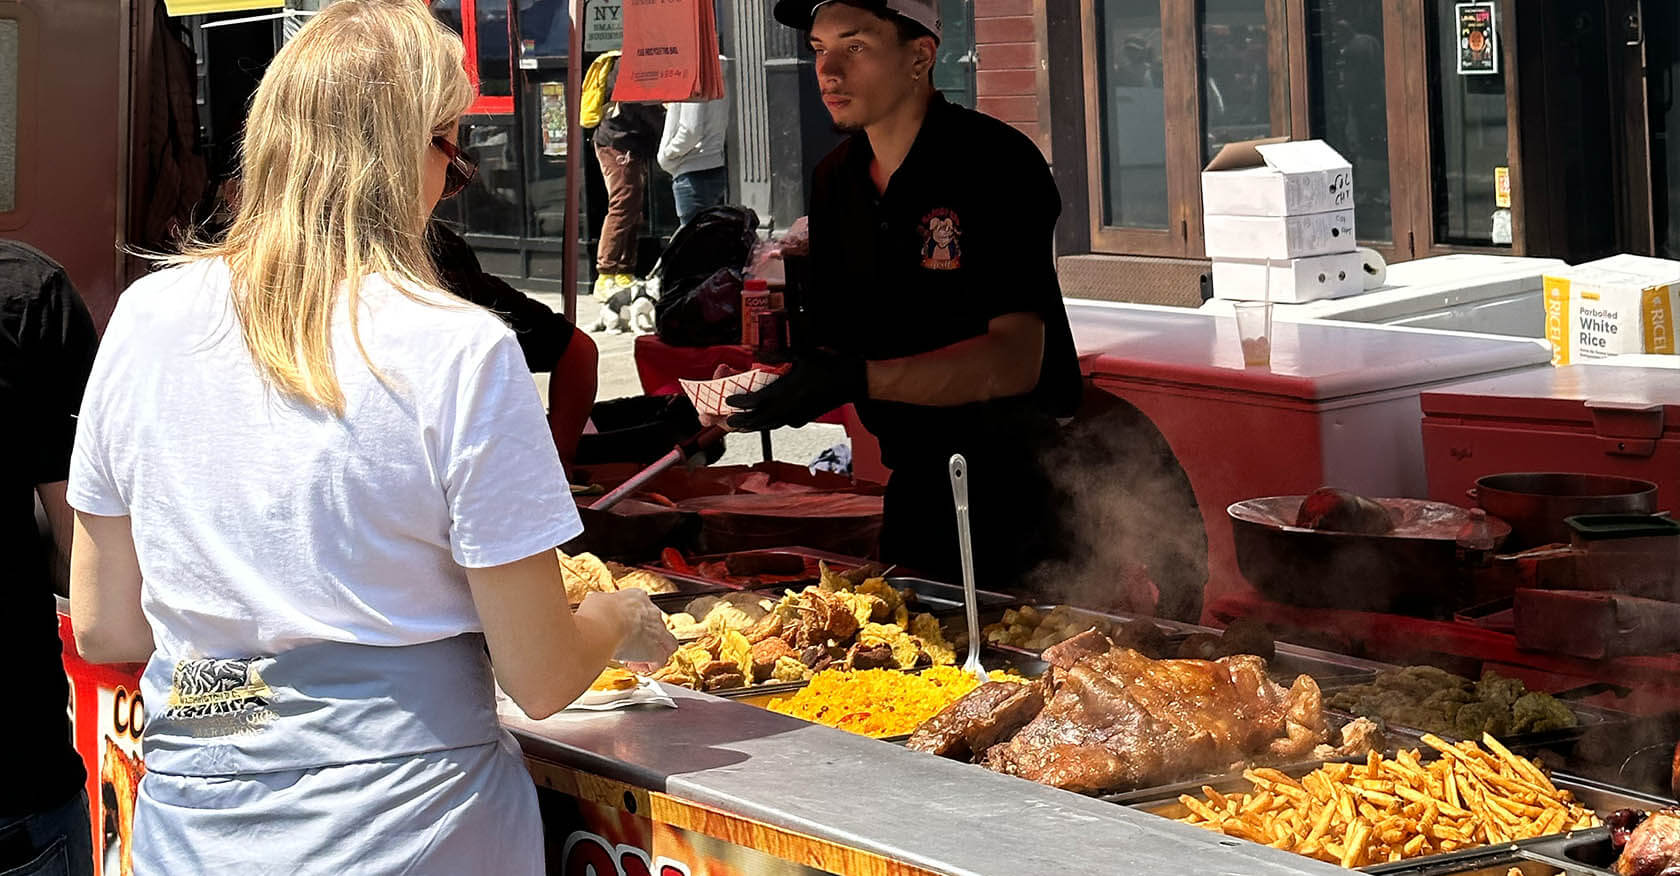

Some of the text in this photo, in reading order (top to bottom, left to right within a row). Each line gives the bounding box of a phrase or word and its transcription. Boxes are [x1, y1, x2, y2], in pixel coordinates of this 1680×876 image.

[594, 5, 620, 21] NY
[1580, 316, 1618, 334] White
[1580, 332, 1606, 348] Rice
